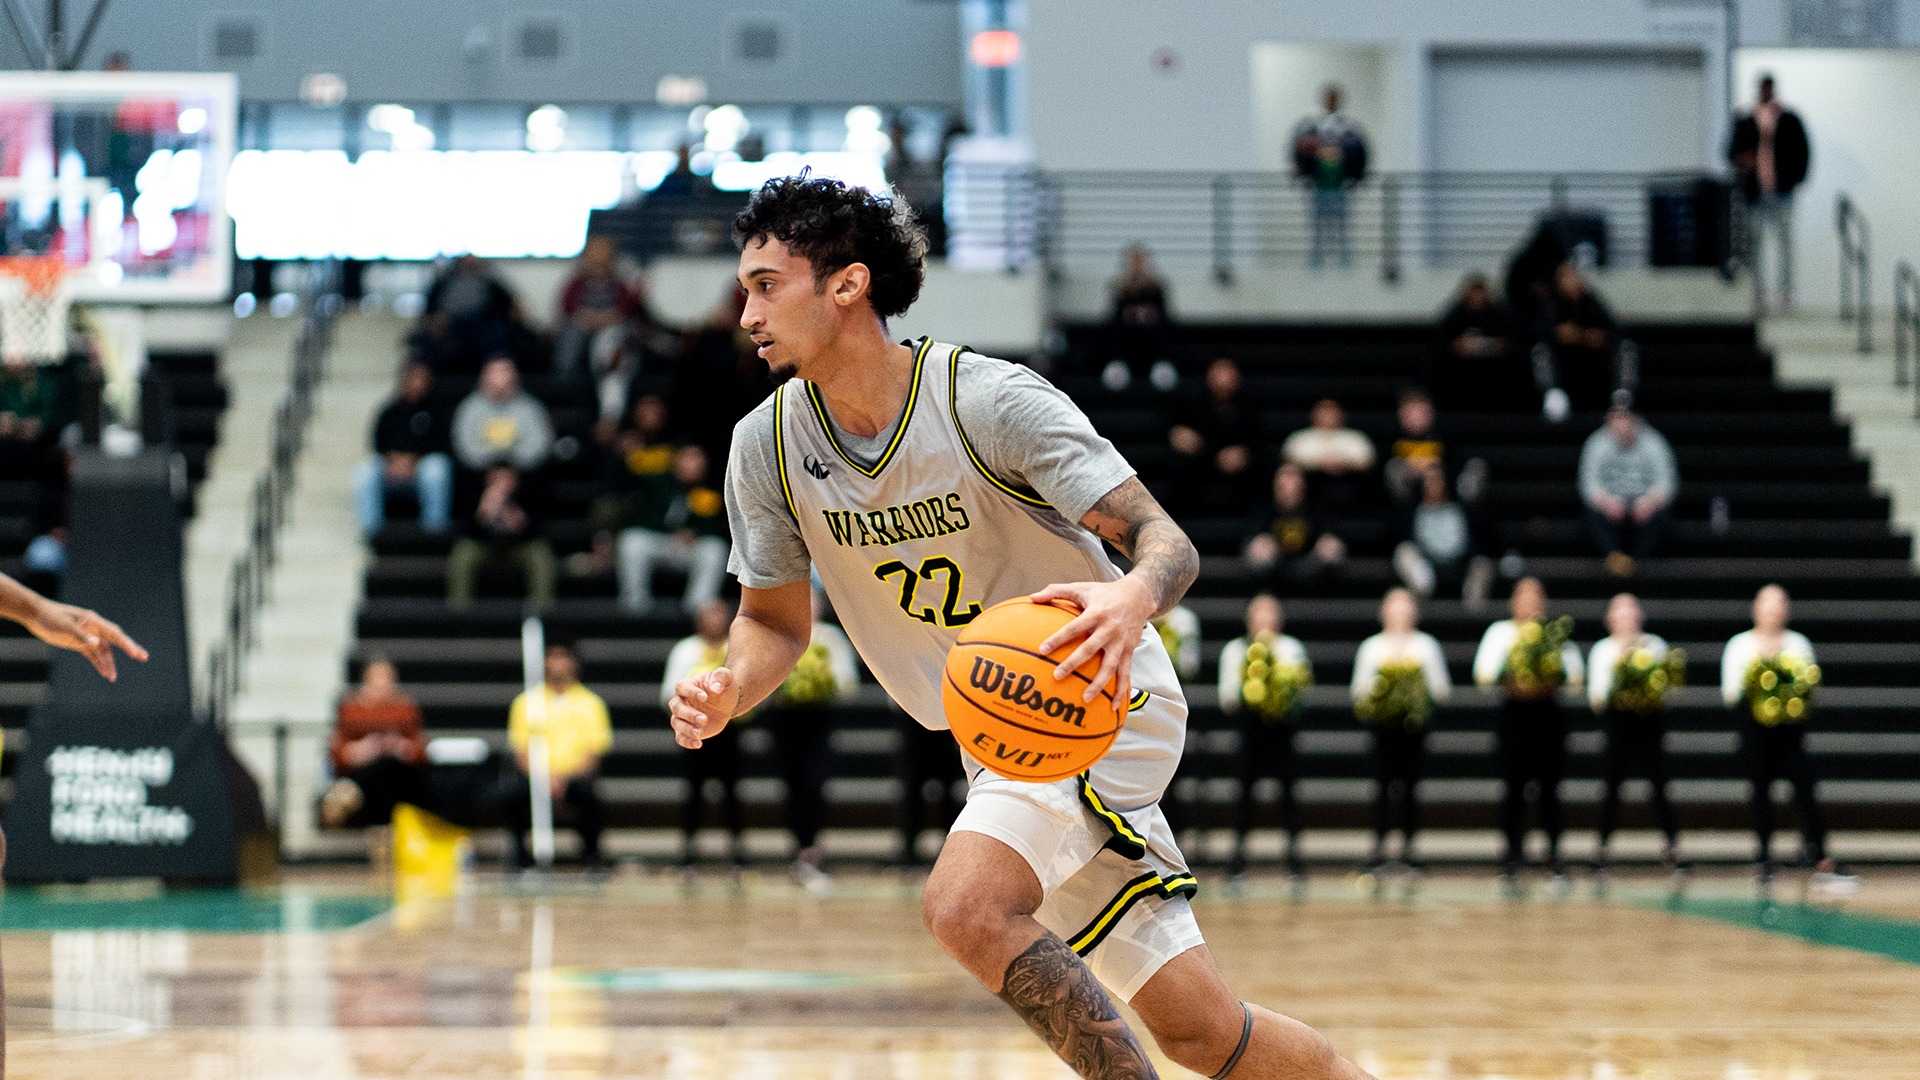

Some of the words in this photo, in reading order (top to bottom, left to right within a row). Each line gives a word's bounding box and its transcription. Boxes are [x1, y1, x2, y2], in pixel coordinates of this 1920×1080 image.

[821, 491, 971, 548] WARRIORS
[872, 553, 984, 629] 22
[969, 654, 1087, 728] Wilson
[972, 732, 1046, 768] EVO
[1046, 751, 1072, 760] NXT
